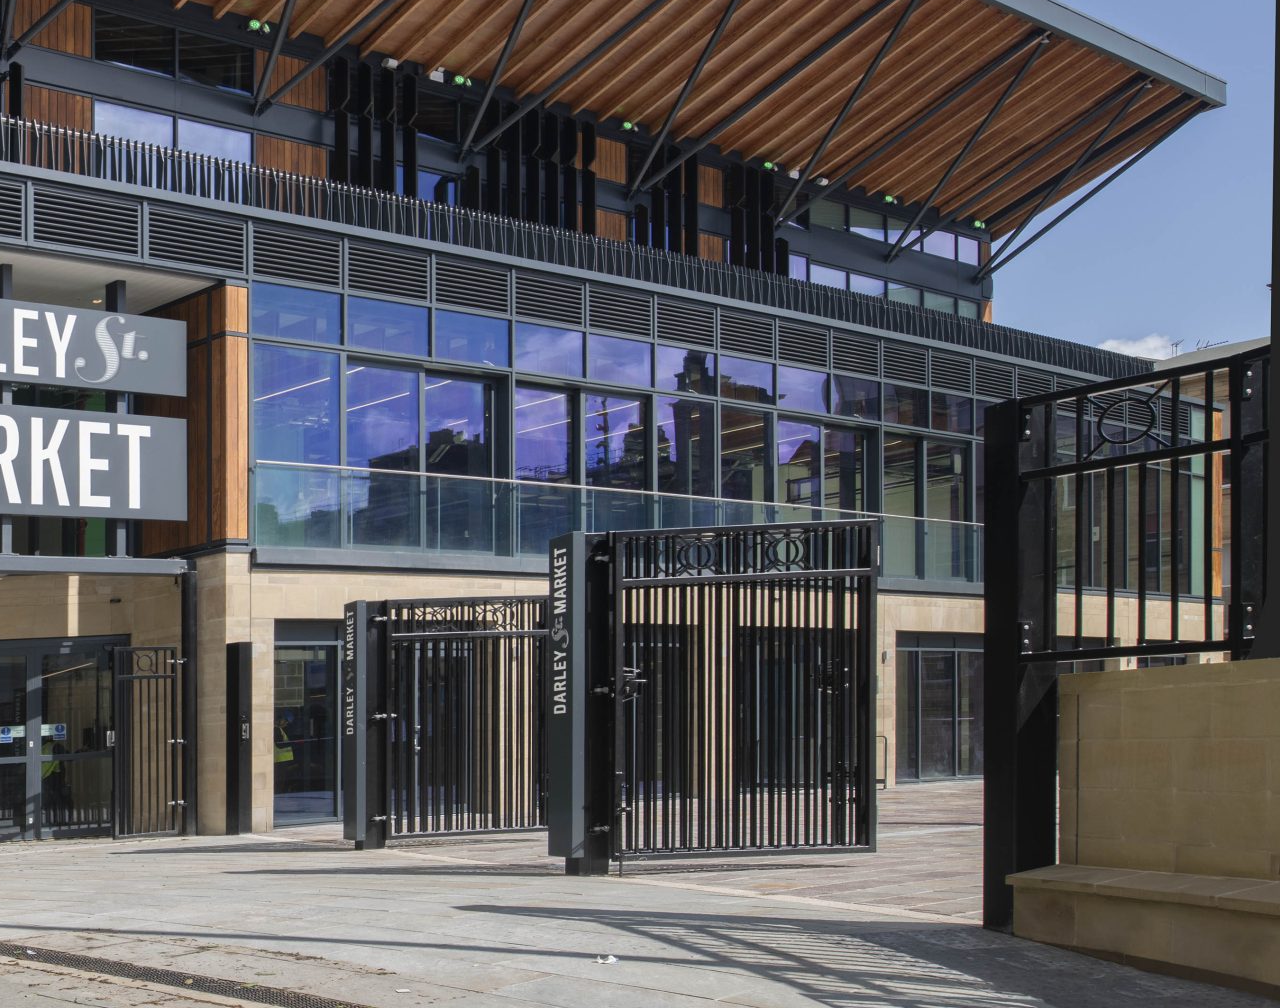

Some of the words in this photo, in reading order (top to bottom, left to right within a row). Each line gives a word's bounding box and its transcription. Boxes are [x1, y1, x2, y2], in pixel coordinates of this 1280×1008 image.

[75, 315, 149, 383] St.
[553, 548, 567, 614] MARKET
[346, 611, 354, 660] MARKET
[346, 687, 354, 735] DARLEY
[553, 650, 567, 715] DARLEY
